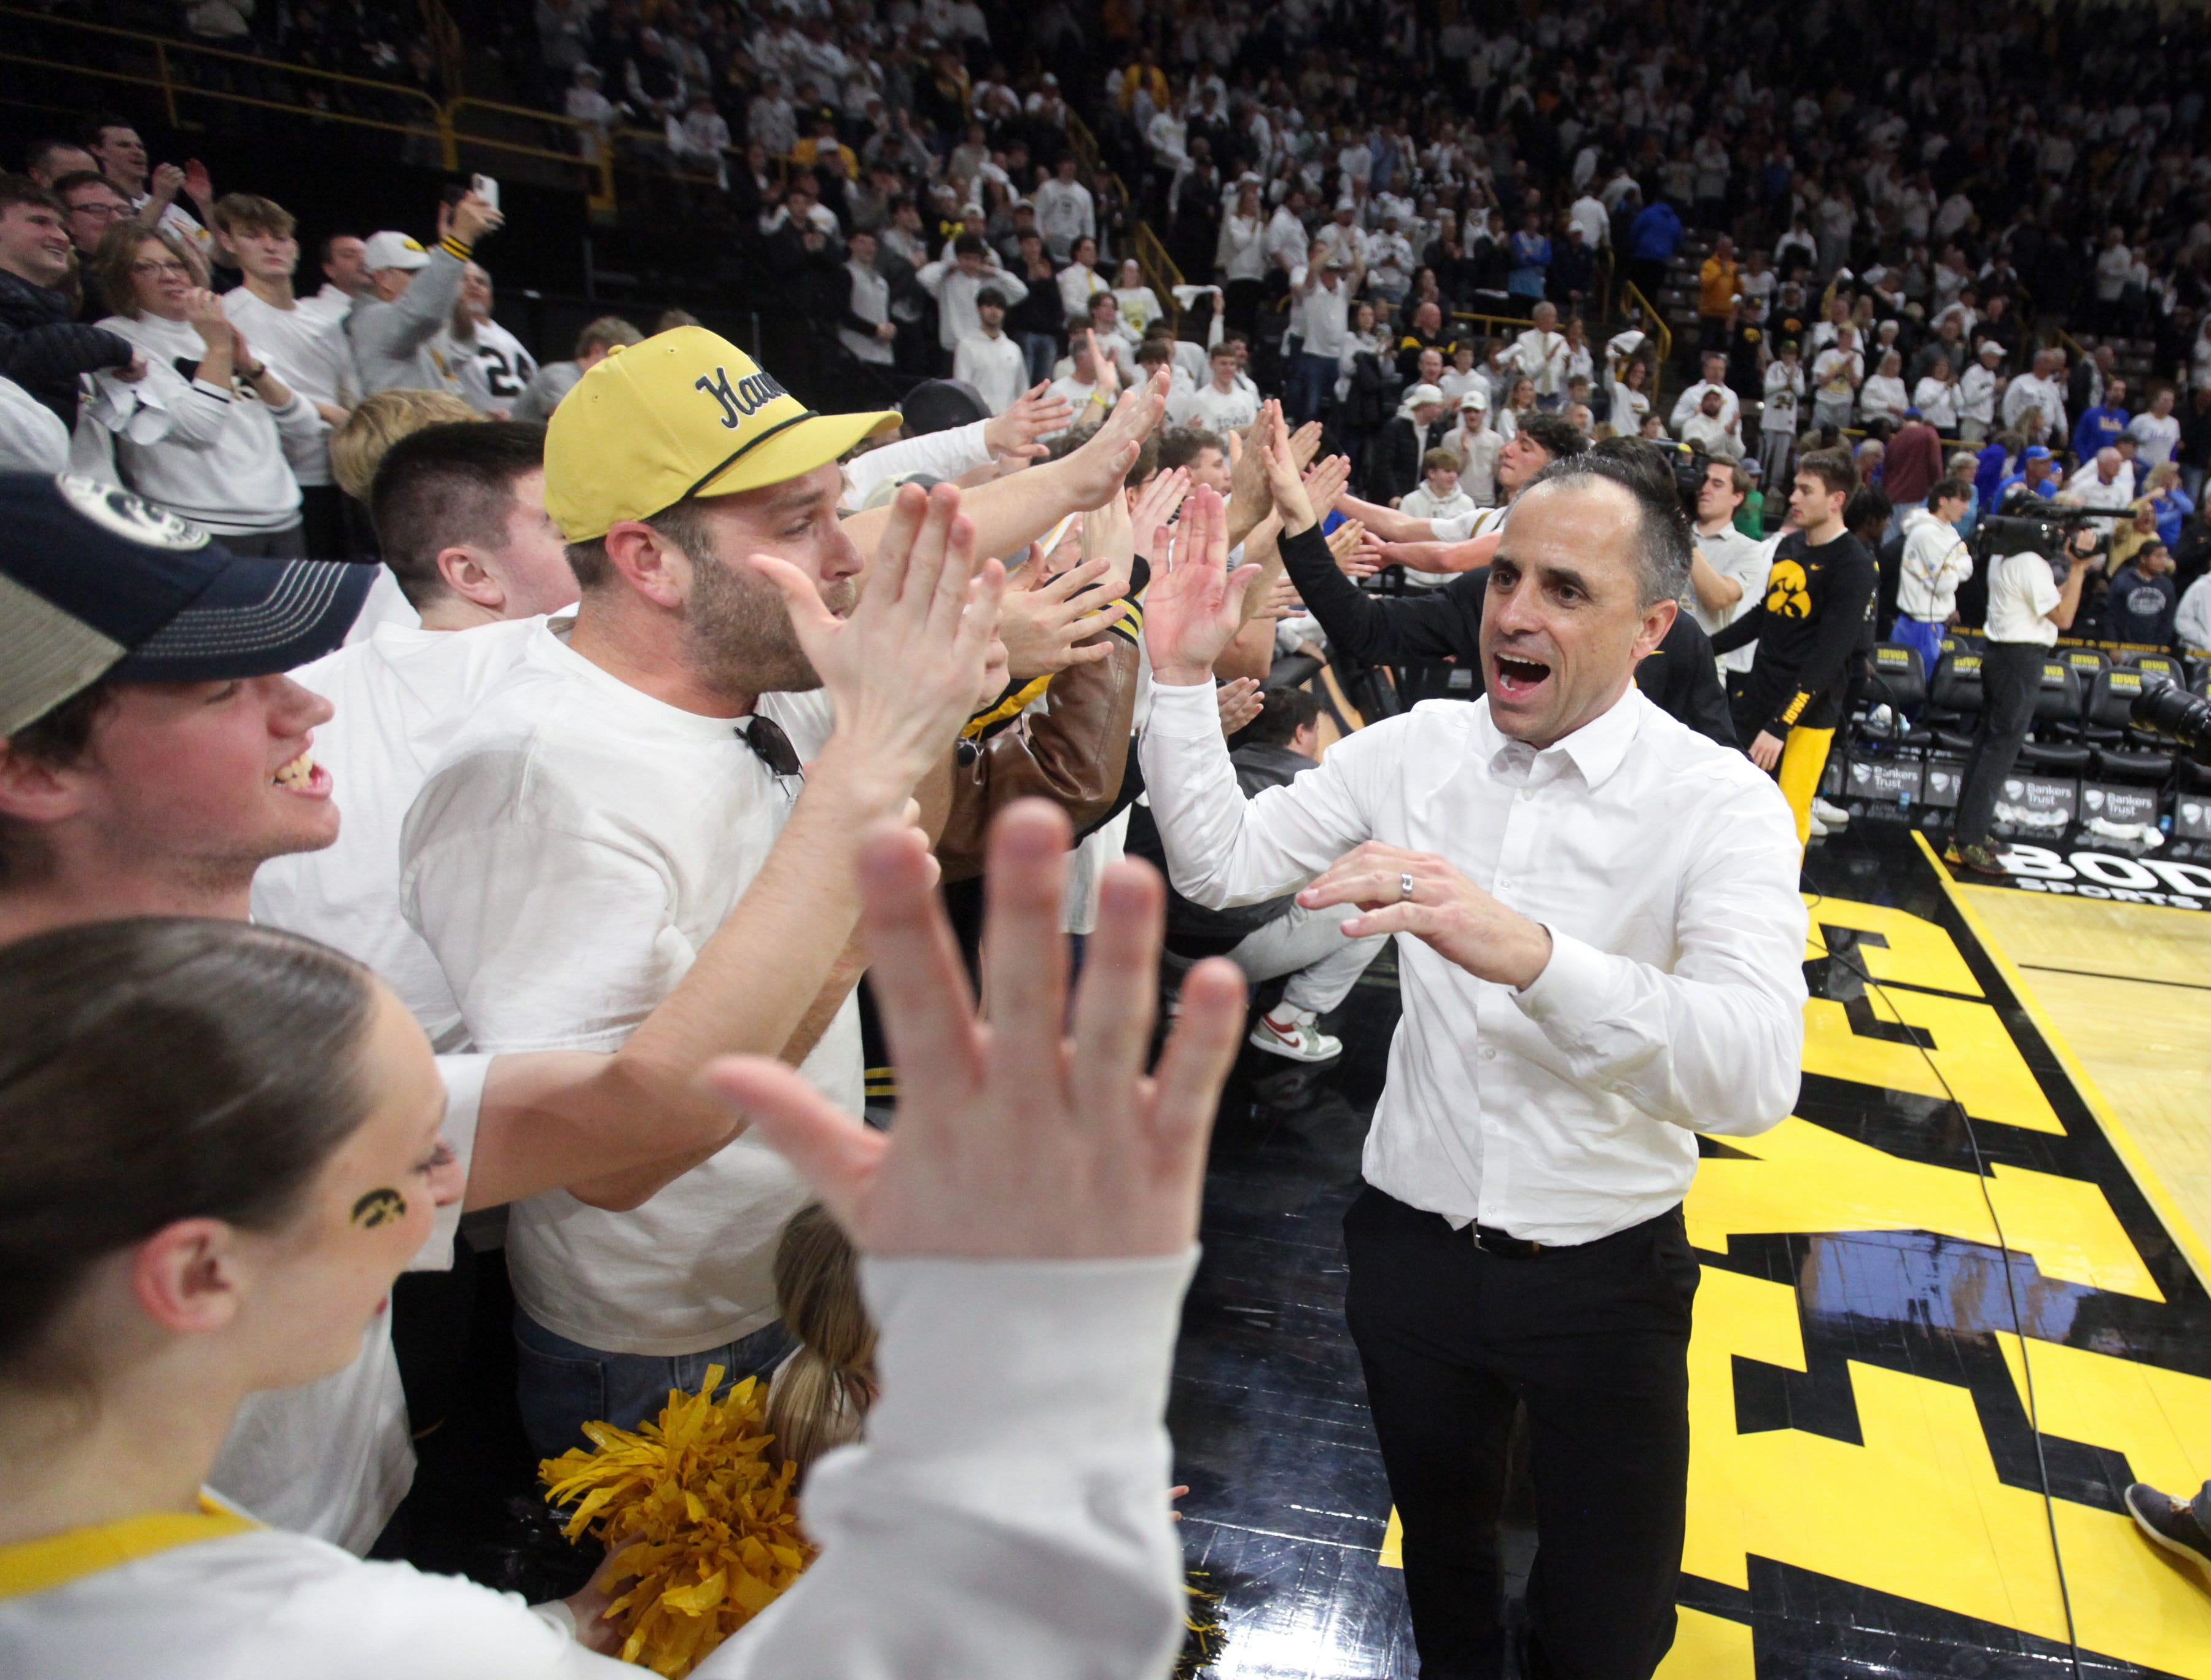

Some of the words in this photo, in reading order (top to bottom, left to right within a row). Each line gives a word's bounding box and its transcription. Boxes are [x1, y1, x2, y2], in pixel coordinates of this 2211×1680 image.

[1877, 648, 1909, 661] IOWA
[2070, 654, 2100, 665] IOWA
[2139, 659, 2170, 671] IOWA
[2109, 672, 2141, 685] IOWA
[1782, 691, 1811, 725] IOWA
[1873, 765, 1918, 781] Bankers
[1874, 776, 1902, 789] Trust
[2026, 782, 2072, 799] Bankers
[2028, 794, 2055, 806] Trust
[2107, 792, 2152, 809] Bankers
[2108, 803, 2136, 816] Trust
[2015, 877, 2203, 909] SPORTS
